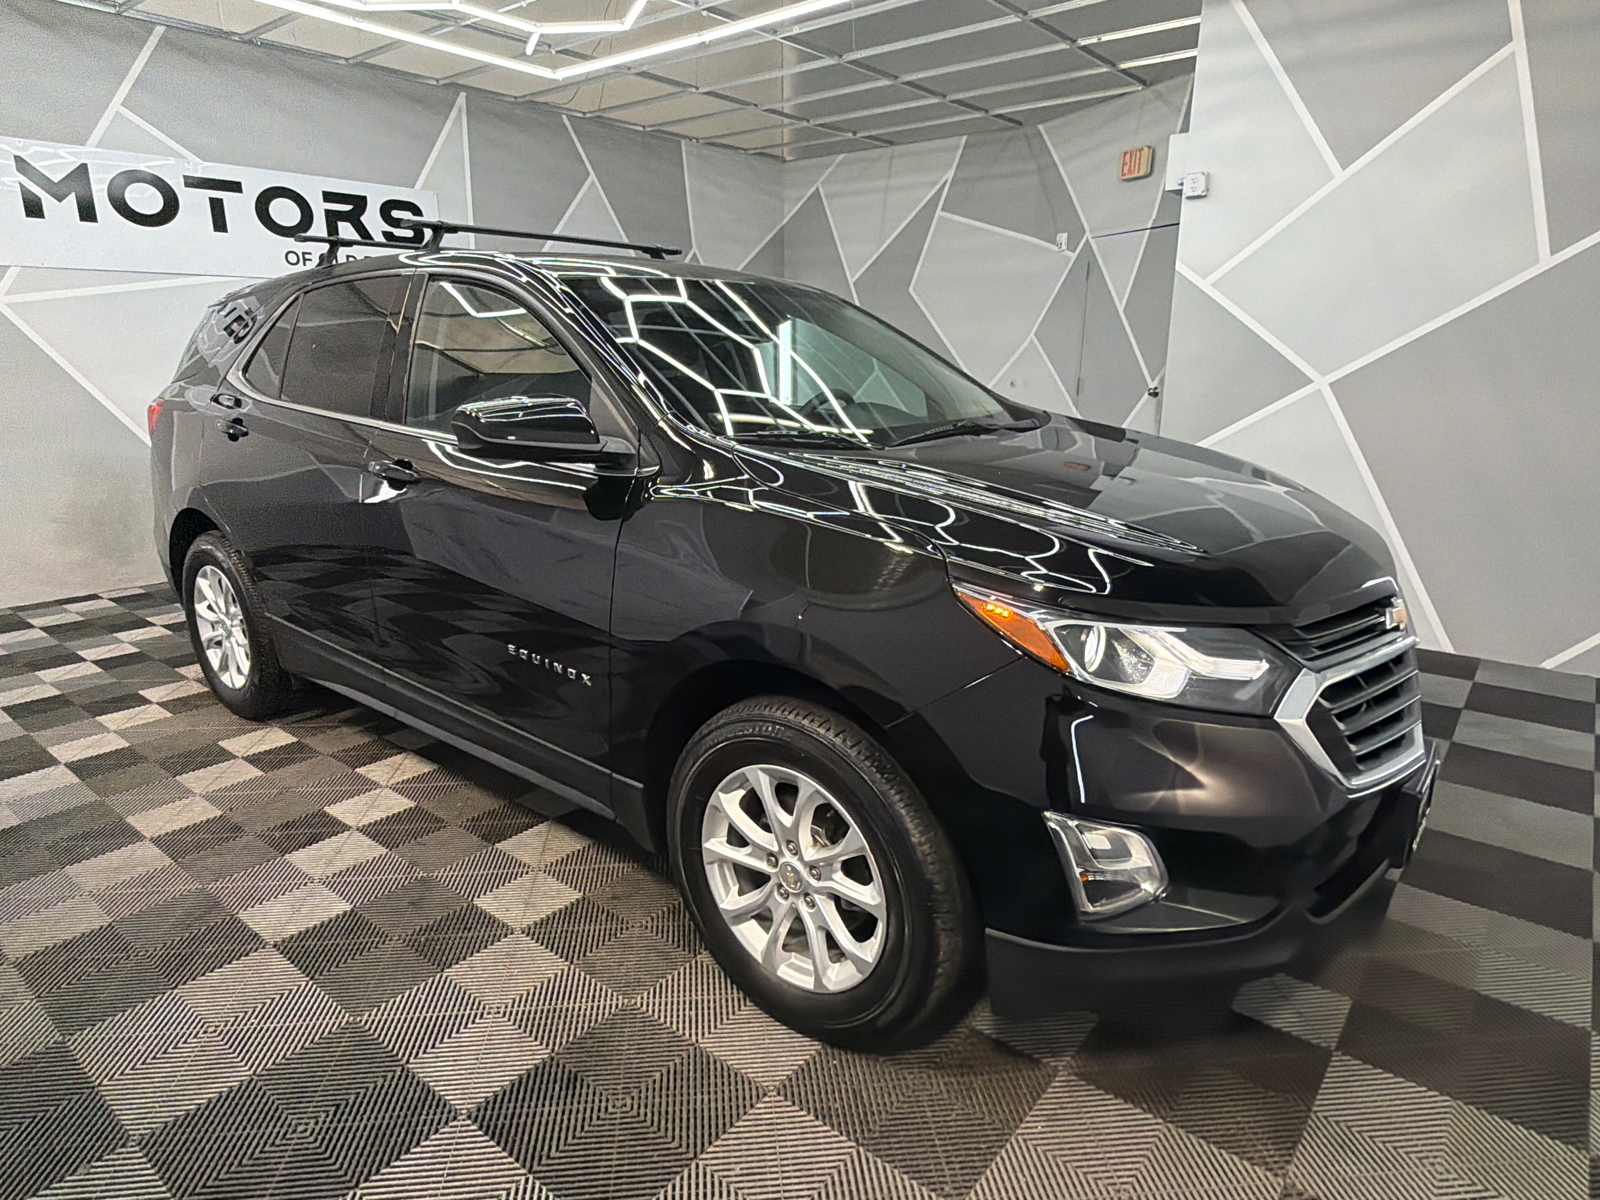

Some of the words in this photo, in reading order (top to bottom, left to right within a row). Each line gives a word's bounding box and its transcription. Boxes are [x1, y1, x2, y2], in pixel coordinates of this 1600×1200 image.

[1121, 148, 1144, 177] EXIT
[13, 154, 426, 246] MOTORS
[285, 250, 312, 267] OF
[507, 643, 592, 687] EQUINOX
